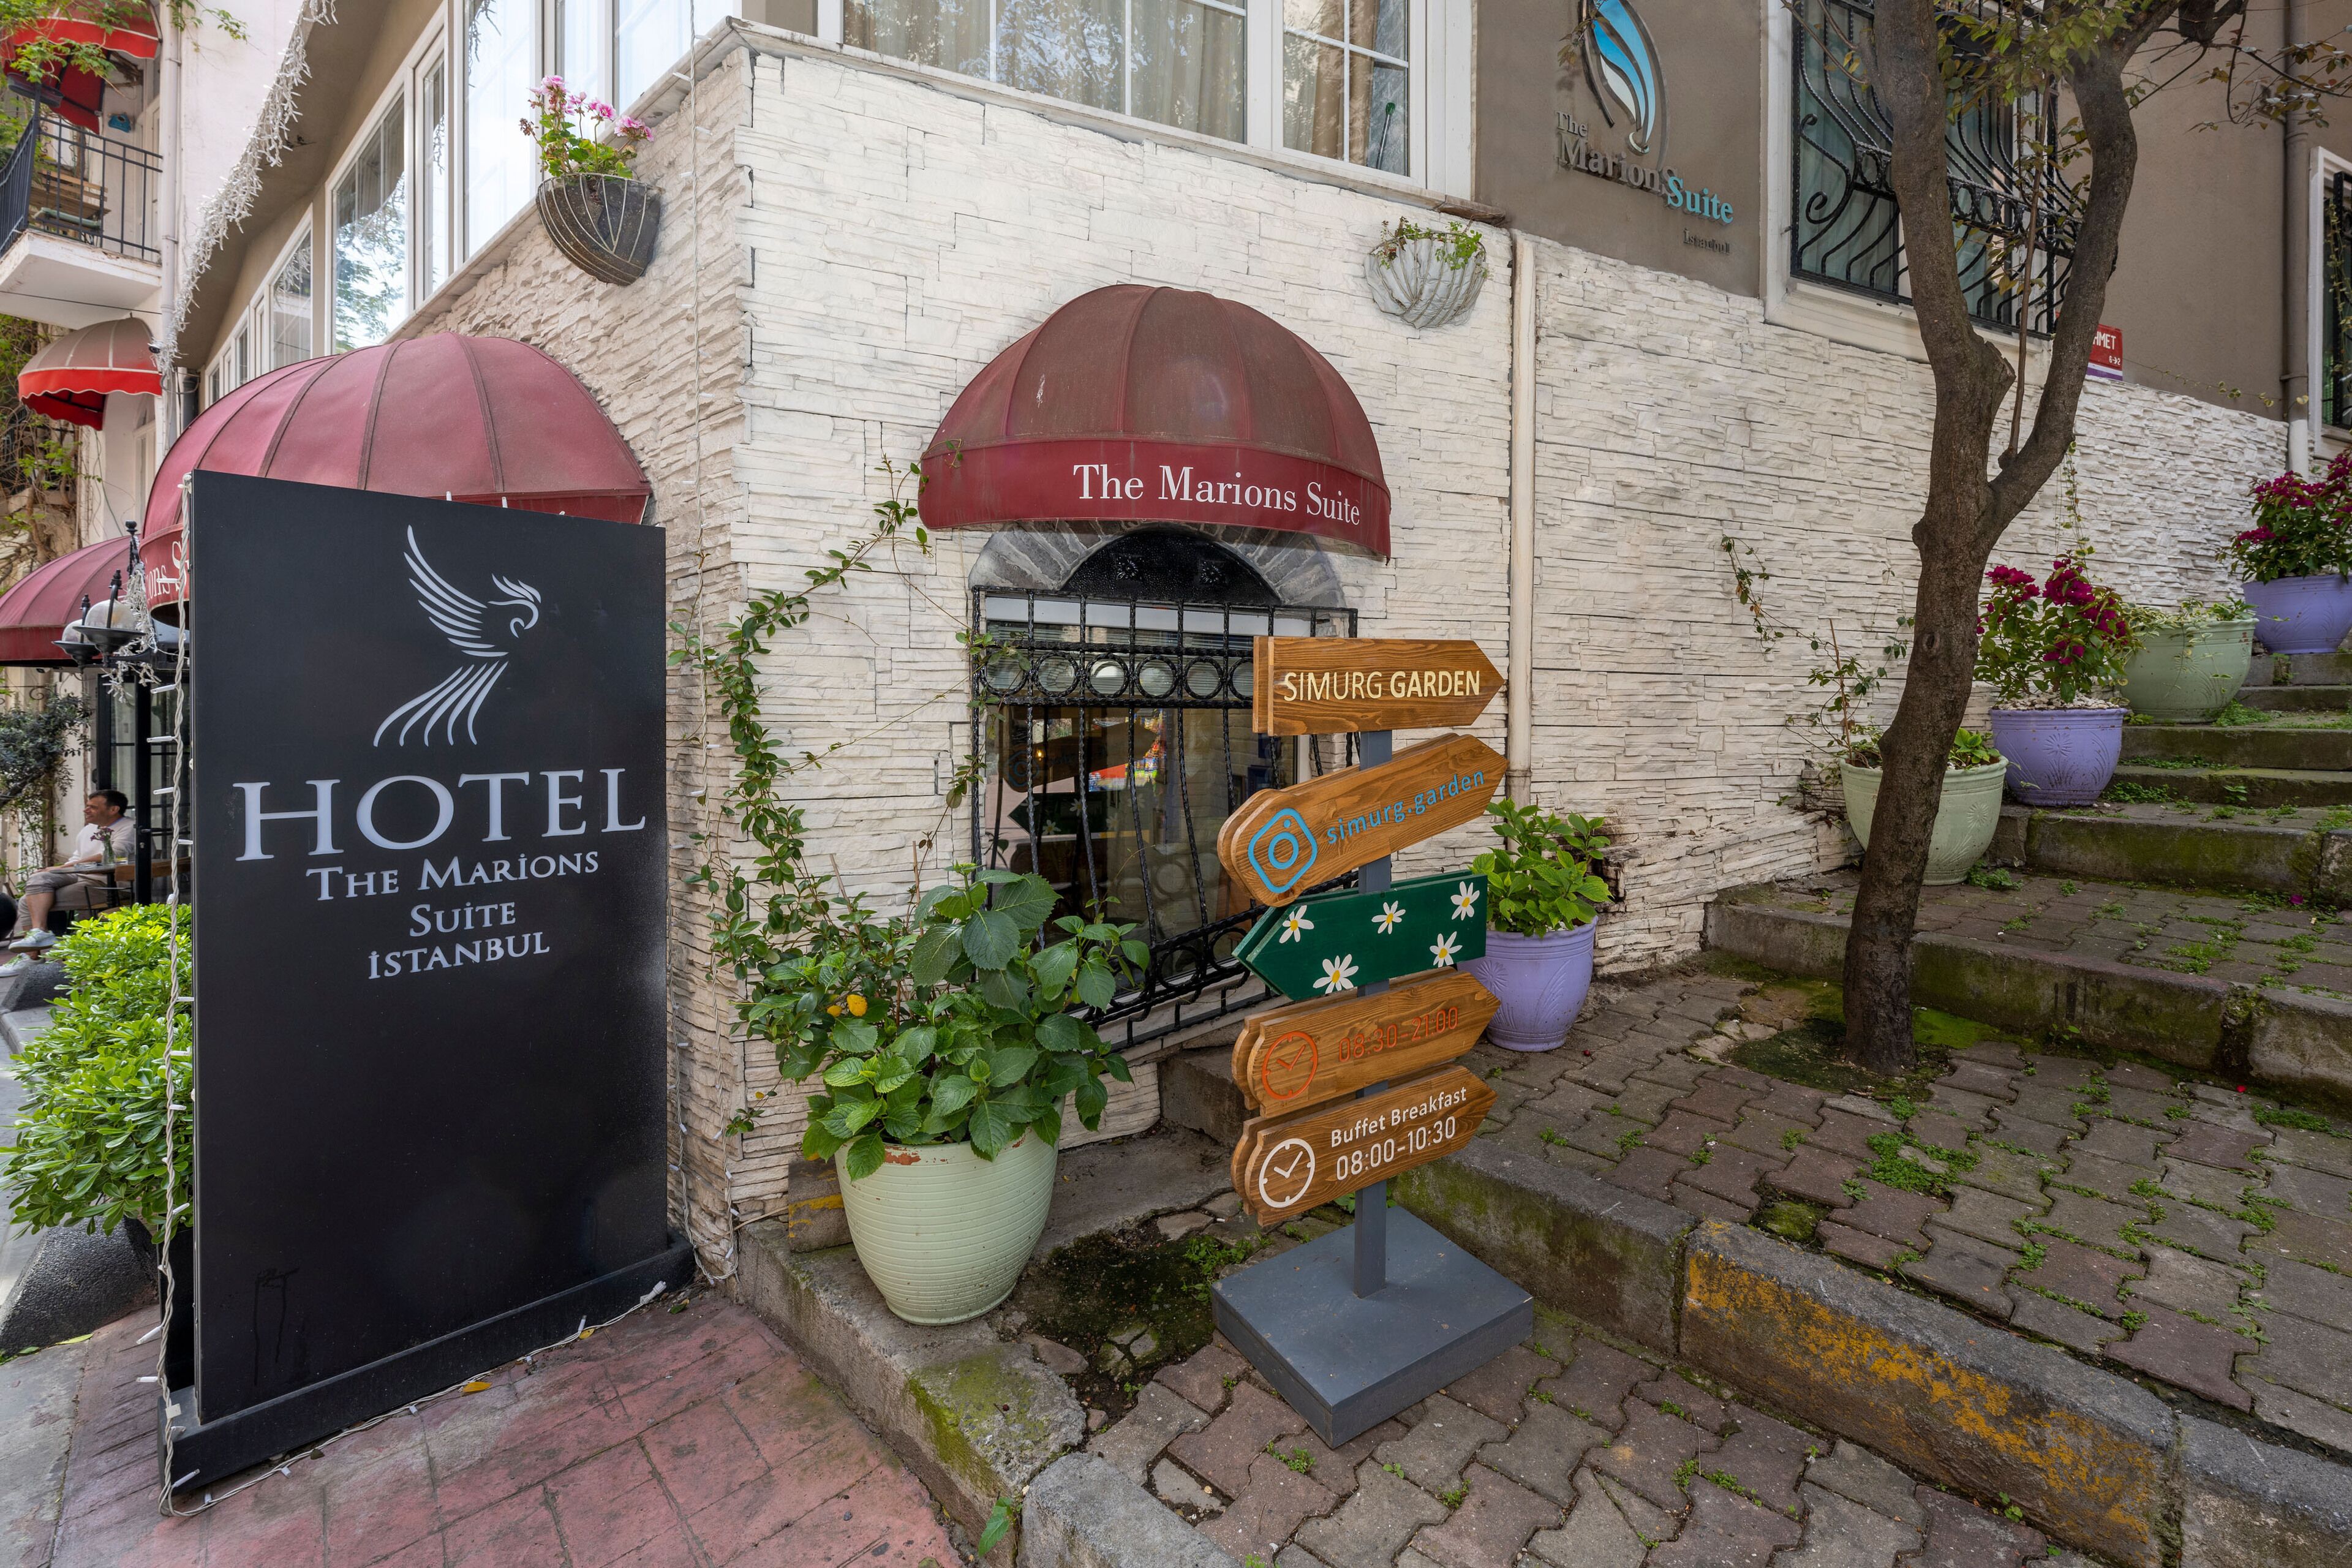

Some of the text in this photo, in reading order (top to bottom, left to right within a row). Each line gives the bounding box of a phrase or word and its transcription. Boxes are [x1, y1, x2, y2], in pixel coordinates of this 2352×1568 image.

[1556, 111, 1588, 137] The
[1667, 176, 1733, 223] Suite
[1073, 464, 1360, 526] The Marions Suite
[1284, 670, 1480, 701] SIMURG GARDEN
[233, 768, 646, 861] HOTEL
[1326, 769, 1485, 844] simurg.garden
[368, 932, 550, 979] İSTANBUL
[1338, 1006, 1458, 1063] 08:30-21:00
[1331, 1086, 1468, 1148] Buffet Breakfast
[1336, 1116, 1456, 1181] 08:00-10:30
